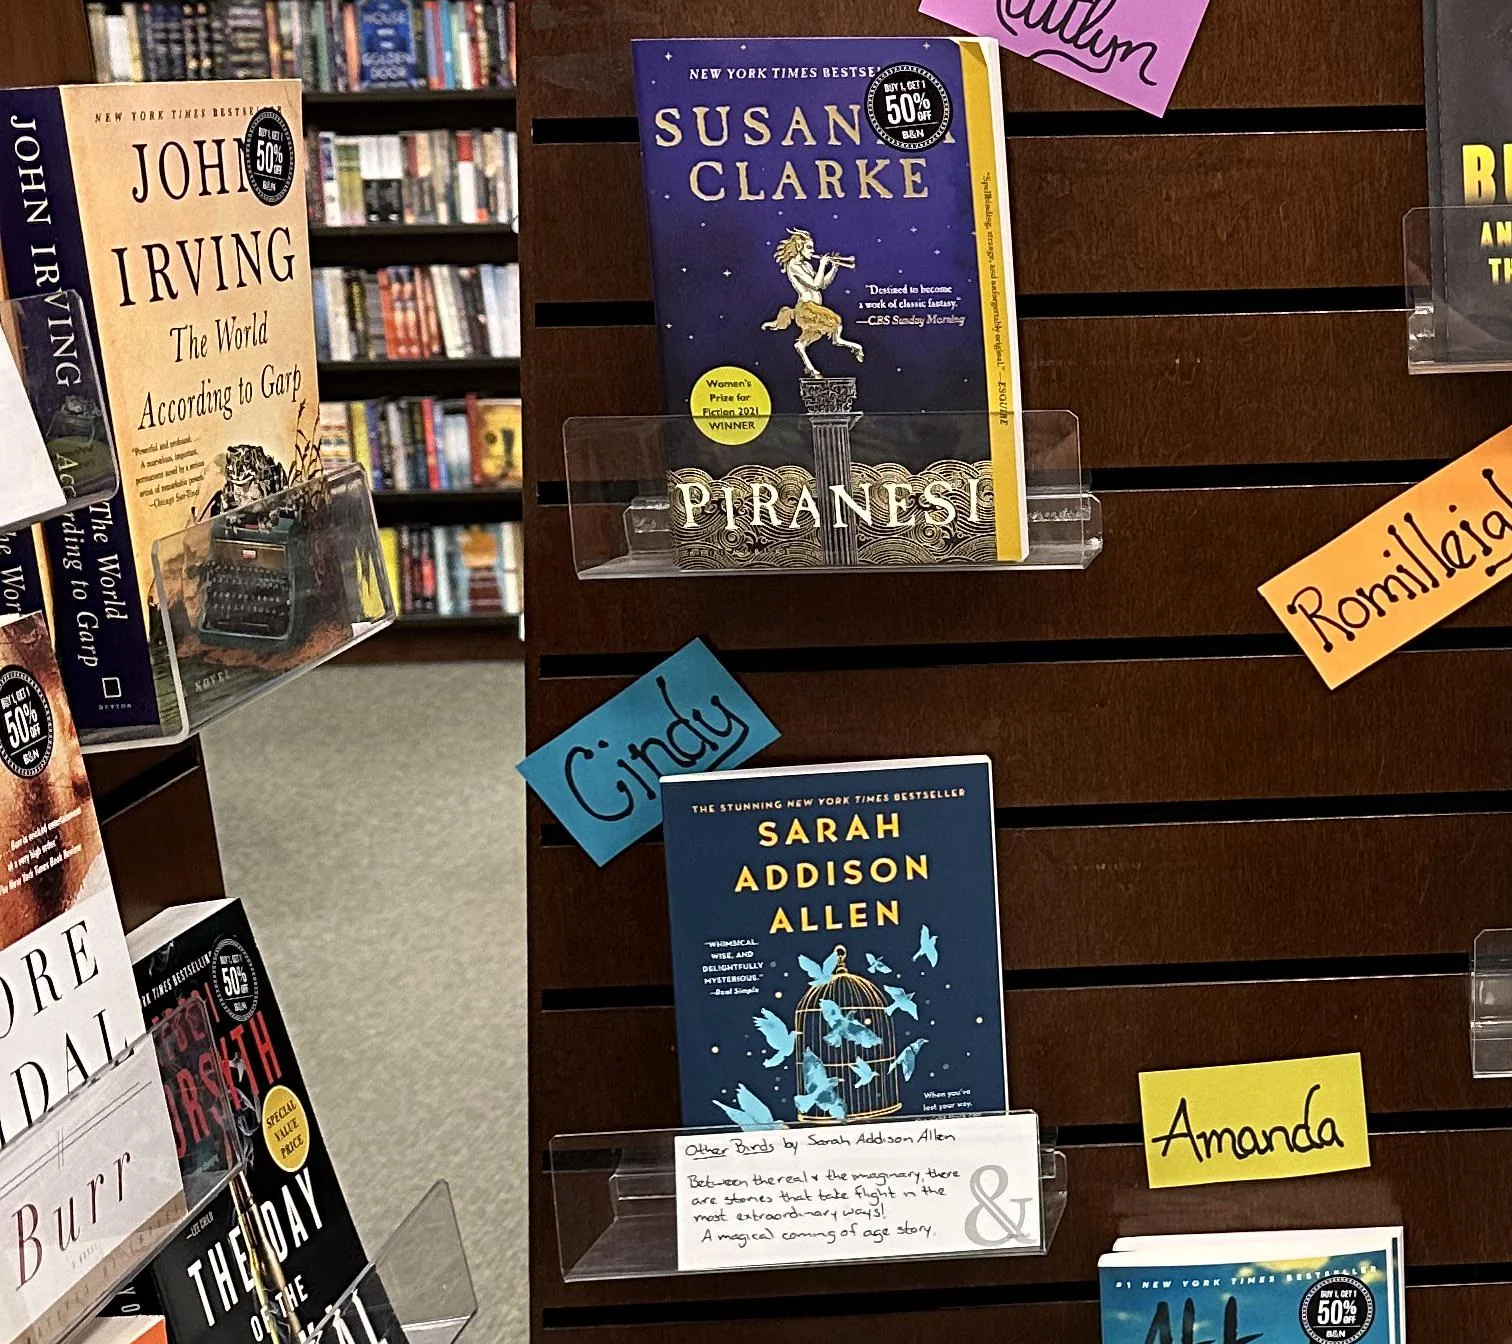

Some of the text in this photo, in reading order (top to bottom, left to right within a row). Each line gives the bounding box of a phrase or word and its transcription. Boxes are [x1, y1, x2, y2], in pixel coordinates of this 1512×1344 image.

[654, 103, 957, 148] SUSAN
[131, 136, 248, 202] JOHN
[688, 157, 930, 202] CLARKE
[112, 226, 297, 308] IRVING
[170, 309, 270, 364] The World
[137, 362, 304, 432] According to Garp
[705, 378, 752, 390] Women's
[708, 392, 751, 404] Prize for
[702, 406, 760, 418] Fiction 2021
[707, 419, 756, 432] WINNER
[674, 478, 985, 531] PIRANESI
[563, 675, 751, 822] Cindy
[691, 787, 967, 815] THE STUNNING NEW YORK TIMES BESTSELLER
[758, 811, 902, 848] SARAH
[733, 853, 930, 894] ADDISON
[768, 899, 901, 936] ALLEN
[265, 1098, 298, 1130] SPECIAL
[273, 1117, 300, 1145] VALUE
[1151, 1083, 1345, 1163] Amanda
[279, 1133, 305, 1163] PRICE
[684, 1142, 730, 1158] Other
[734, 1137, 775, 1156] Birds
[782, 1136, 799, 1158] by
[806, 1132, 851, 1147] Sarah
[917, 1128, 957, 1144] Allen
[11, 1150, 134, 1293] Burr
[187, 1167, 324, 1328] THE DAY
[250, 1274, 311, 1344] OF THE
